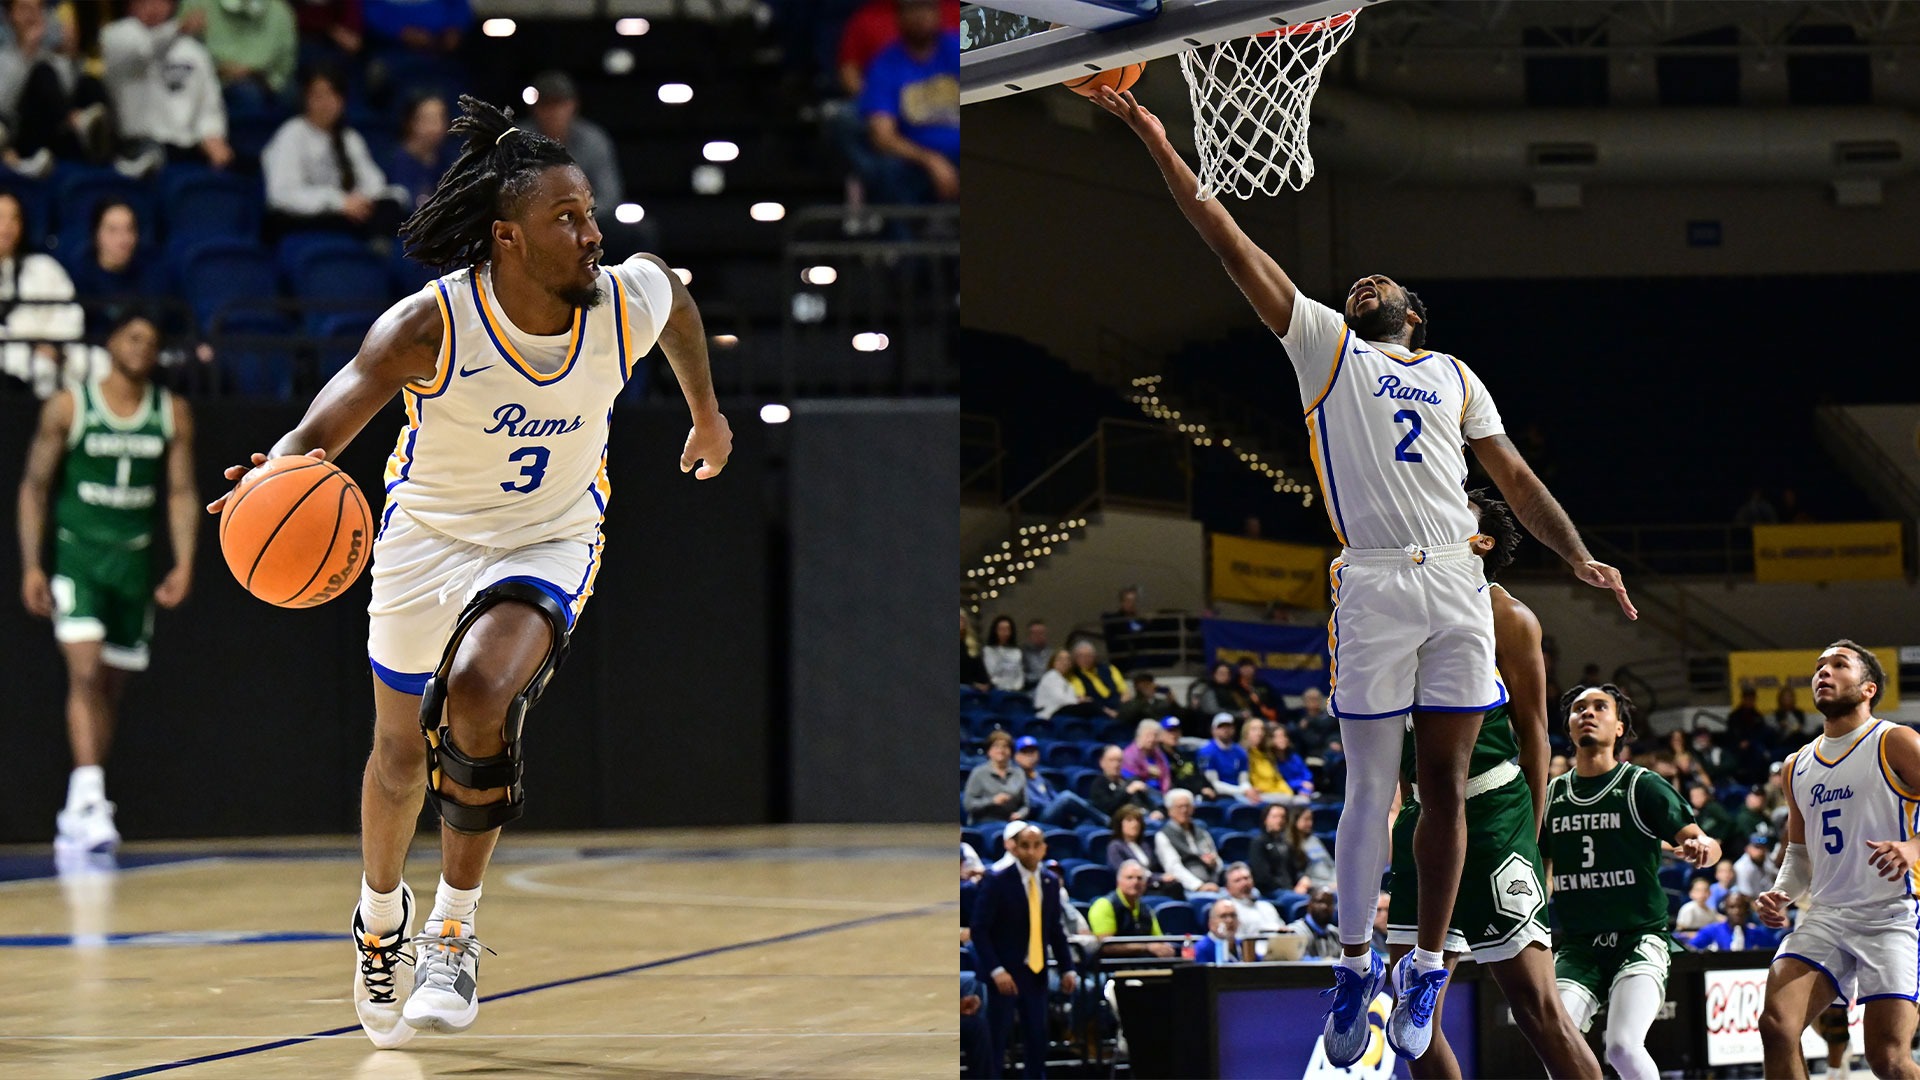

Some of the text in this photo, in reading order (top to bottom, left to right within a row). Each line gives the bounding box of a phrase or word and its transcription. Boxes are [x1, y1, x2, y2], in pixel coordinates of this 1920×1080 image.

[1373, 375, 1442, 405] Rams
[483, 403, 586, 437] Rams
[1393, 409, 1423, 463] 2
[500, 446, 551, 494] 3
[1809, 783, 1854, 807] Rams
[1552, 813, 1621, 834] EASTERN
[1822, 808, 1844, 855] 5
[1581, 835, 1595, 868] 3
[1552, 869, 1636, 892] NEW MEXICO
